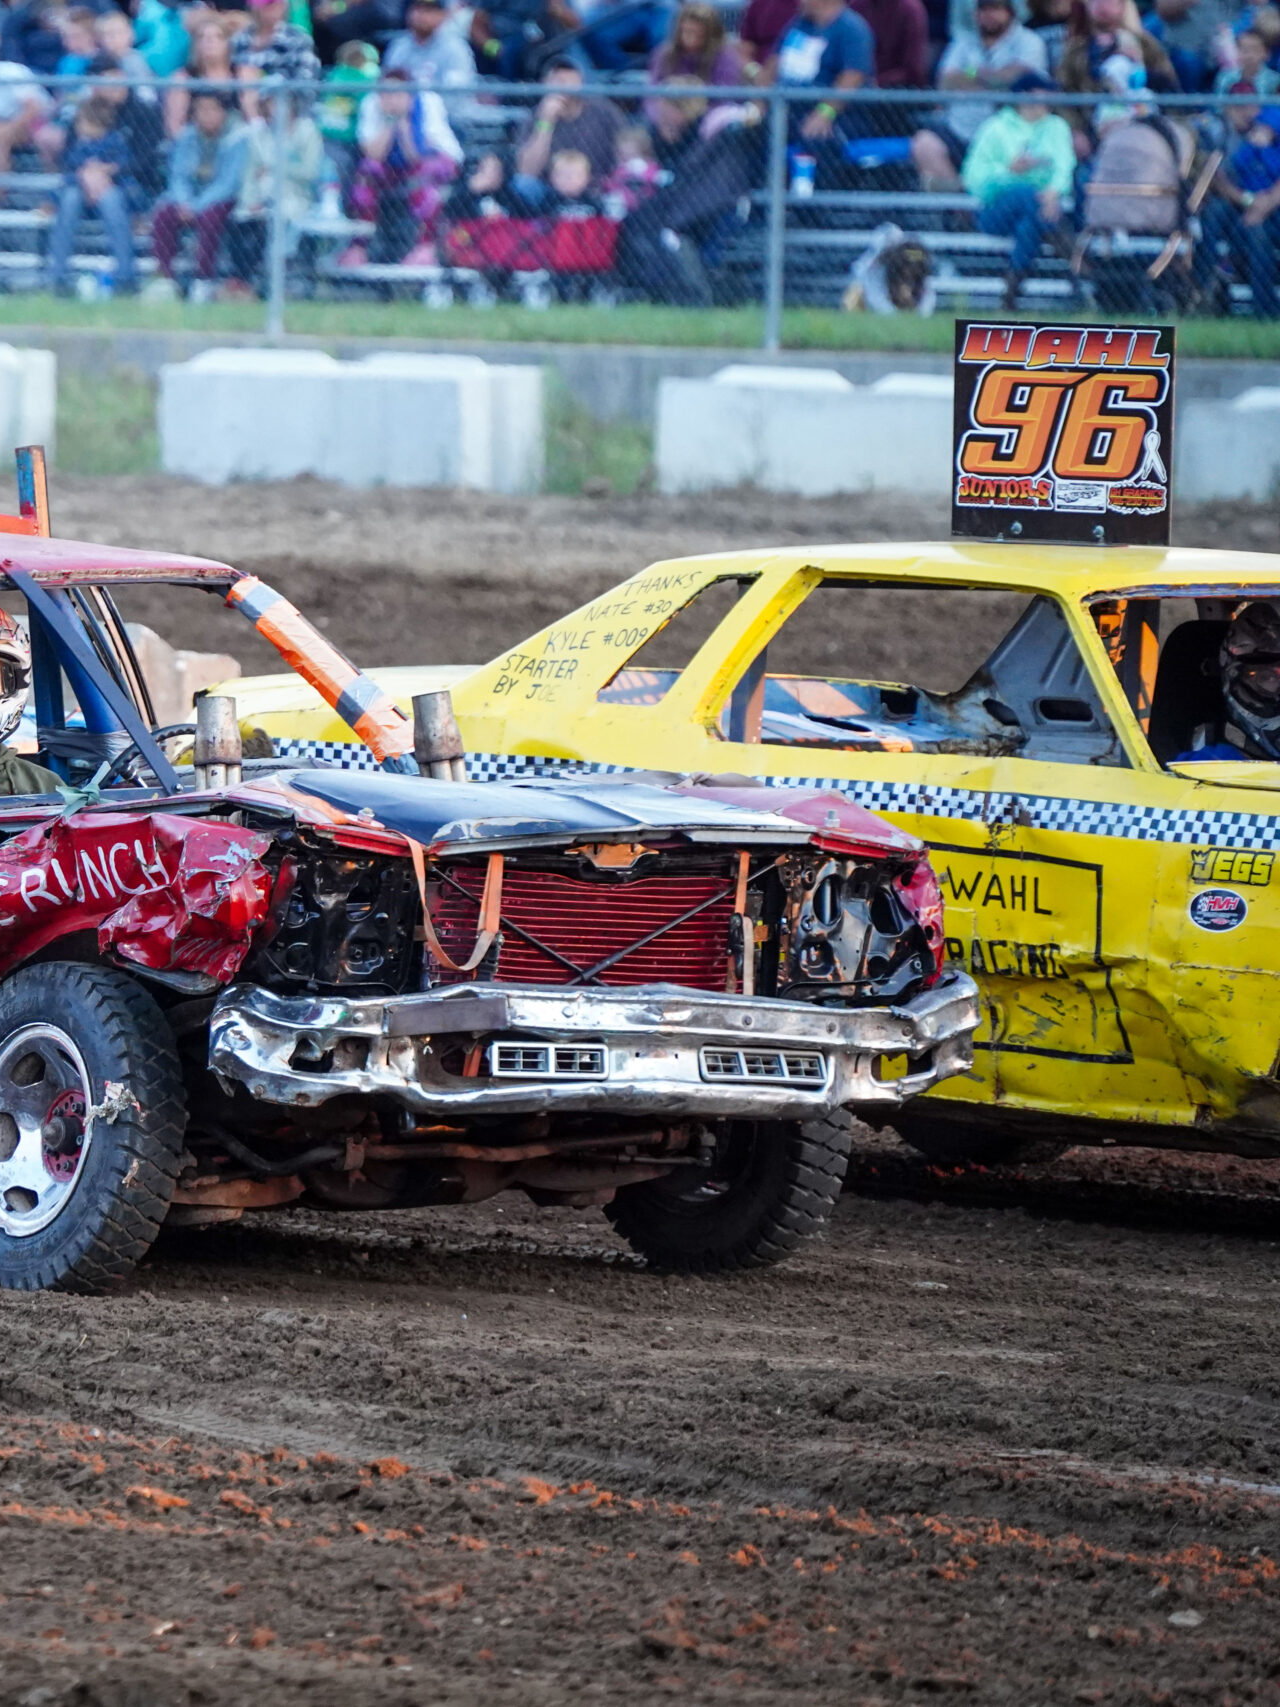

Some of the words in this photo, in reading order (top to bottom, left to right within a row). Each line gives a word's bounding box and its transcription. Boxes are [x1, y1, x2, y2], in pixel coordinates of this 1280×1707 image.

[960, 325, 1170, 367] WAHL
[960, 367, 1162, 480] 96
[624, 571, 702, 597] THANKS
[584, 601, 638, 622] NATE
[644, 600, 673, 615] #30
[544, 630, 591, 654] KYLE
[603, 627, 648, 648] #009
[500, 654, 578, 680] STARTER
[493, 674, 519, 695] BY
[526, 683, 561, 702] JOE
[1190, 848, 1276, 887] JEGS
[946, 866, 1053, 915] WAHL
[943, 937, 1070, 979] RACING
